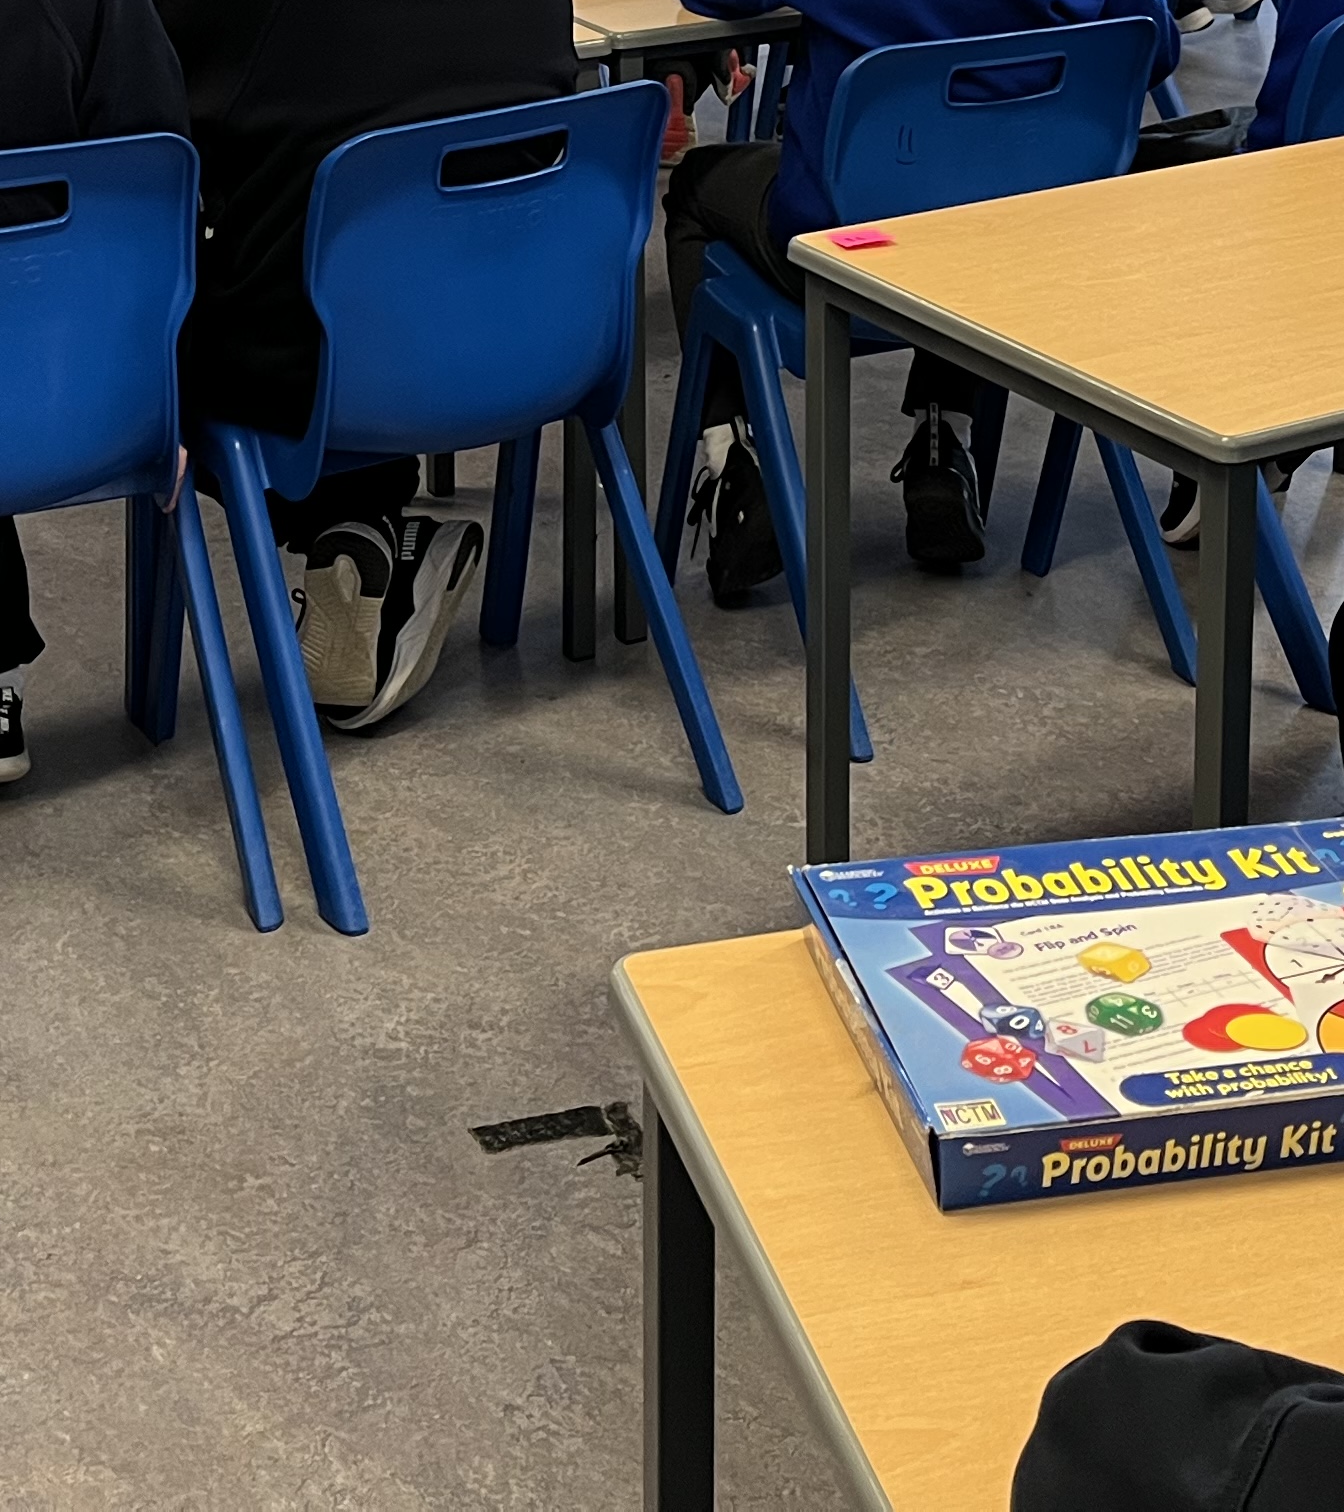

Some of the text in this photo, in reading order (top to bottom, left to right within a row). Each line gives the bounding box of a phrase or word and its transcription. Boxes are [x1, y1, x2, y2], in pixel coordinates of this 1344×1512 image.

[903, 855, 1227, 910] Probability
[1227, 844, 1321, 879] Kit
[919, 858, 993, 876] DELUXE
[1034, 922, 1138, 955] Flip and Spin
[1164, 1059, 1312, 1087] Take a chance
[1165, 1067, 1338, 1100] with probability!
[940, 1103, 1001, 1127] NCTM
[1041, 1119, 1338, 1189] Probability Kit
[1069, 1137, 1115, 1151] DELUXE
